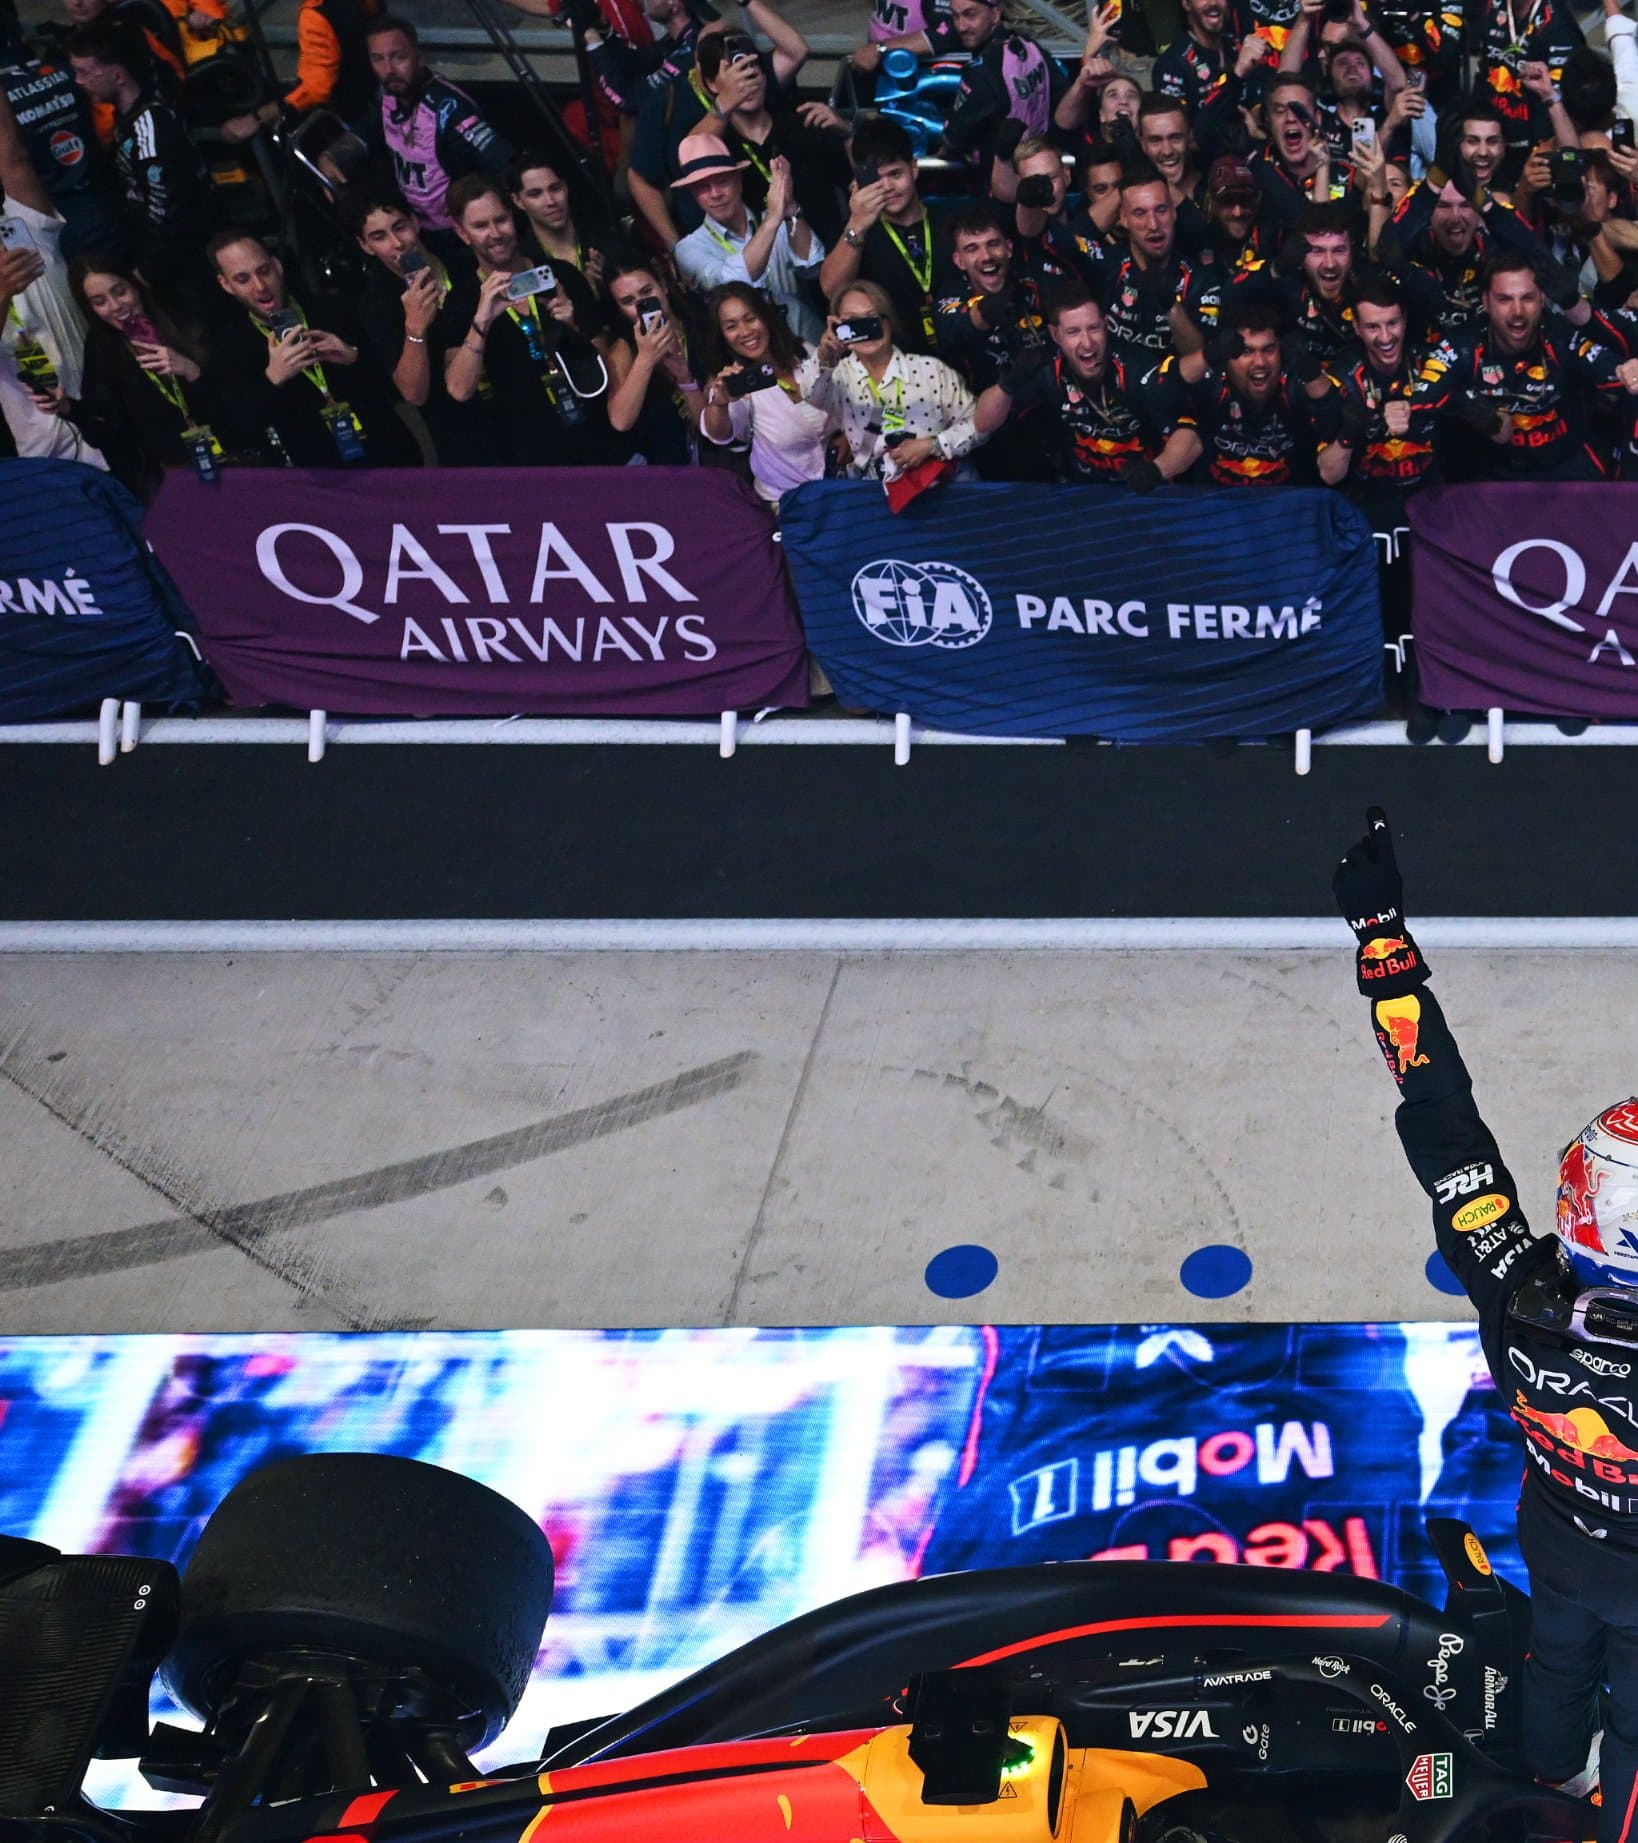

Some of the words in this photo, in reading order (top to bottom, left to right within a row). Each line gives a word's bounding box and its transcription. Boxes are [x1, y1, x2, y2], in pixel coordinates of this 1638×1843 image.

[16, 92, 76, 126] KOMATSU
[256, 521, 698, 625] QATAR
[1015, 593, 1149, 638] PARC
[1168, 596, 1323, 641] FERMÉ
[400, 614, 717, 663] AIRWAYS
[1360, 960, 1386, 981] Red
[1387, 950, 1417, 976] Bull
[1457, 1200, 1497, 1227] RAUCH
[1474, 1227, 1508, 1263] AT&T
[1491, 1237, 1533, 1280] VISA
[1568, 1348, 1632, 1379] sparco
[1093, 1420, 1335, 1510] Mobil
[1427, 1633, 1465, 1686] Pepe
[1203, 1670, 1272, 1689] AVATRADE
[1128, 1710, 1221, 1739] VISA
[1352, 1719, 1388, 1734] obil
[1370, 1683, 1418, 1734] ORACLE
[1258, 1723, 1270, 1760] Gate
[1411, 1757, 1429, 1797] HEUER
[1436, 1756, 1449, 1794] TAG
